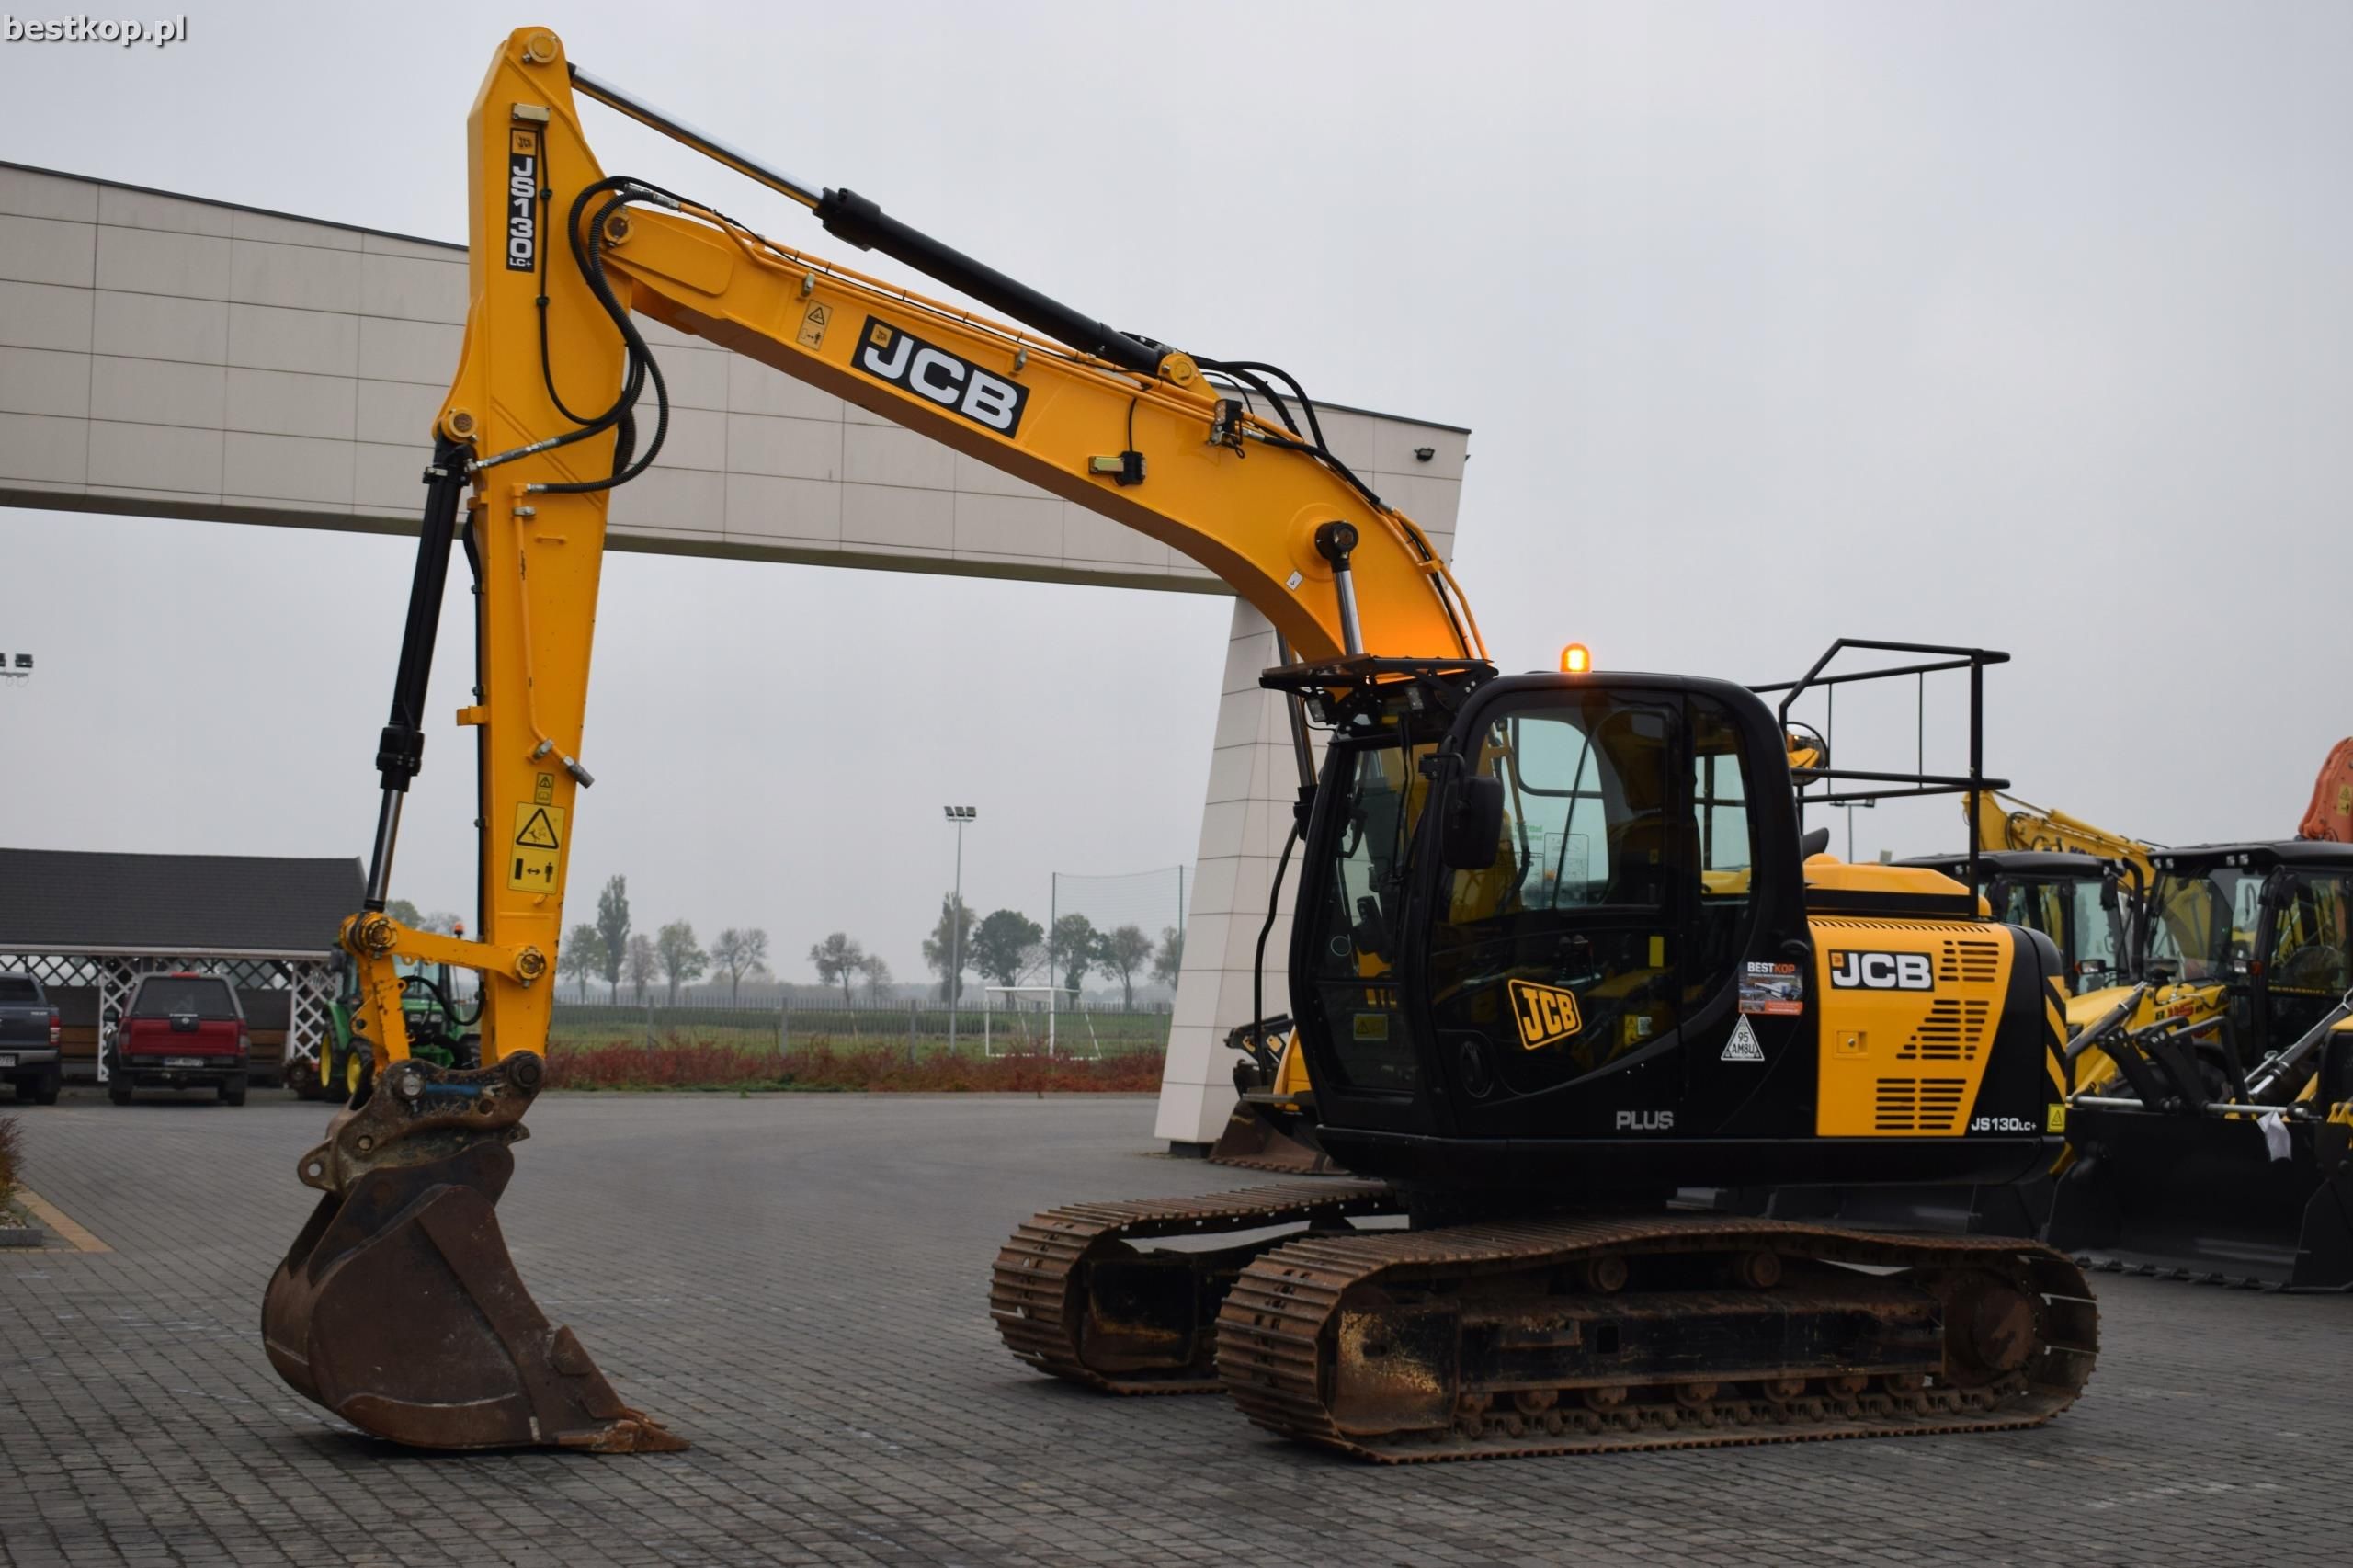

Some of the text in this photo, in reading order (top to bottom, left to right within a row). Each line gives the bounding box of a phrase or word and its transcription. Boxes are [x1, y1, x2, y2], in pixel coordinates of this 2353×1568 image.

[509, 157, 535, 258] JS130
[863, 335, 1017, 429] JCB
[1747, 961, 1795, 973] BESTKOP
[1832, 953, 1932, 989] JCB
[1521, 987, 1577, 1041] JCB
[1737, 1031, 1749, 1043] 95
[1616, 1110, 1675, 1130] PLUS
